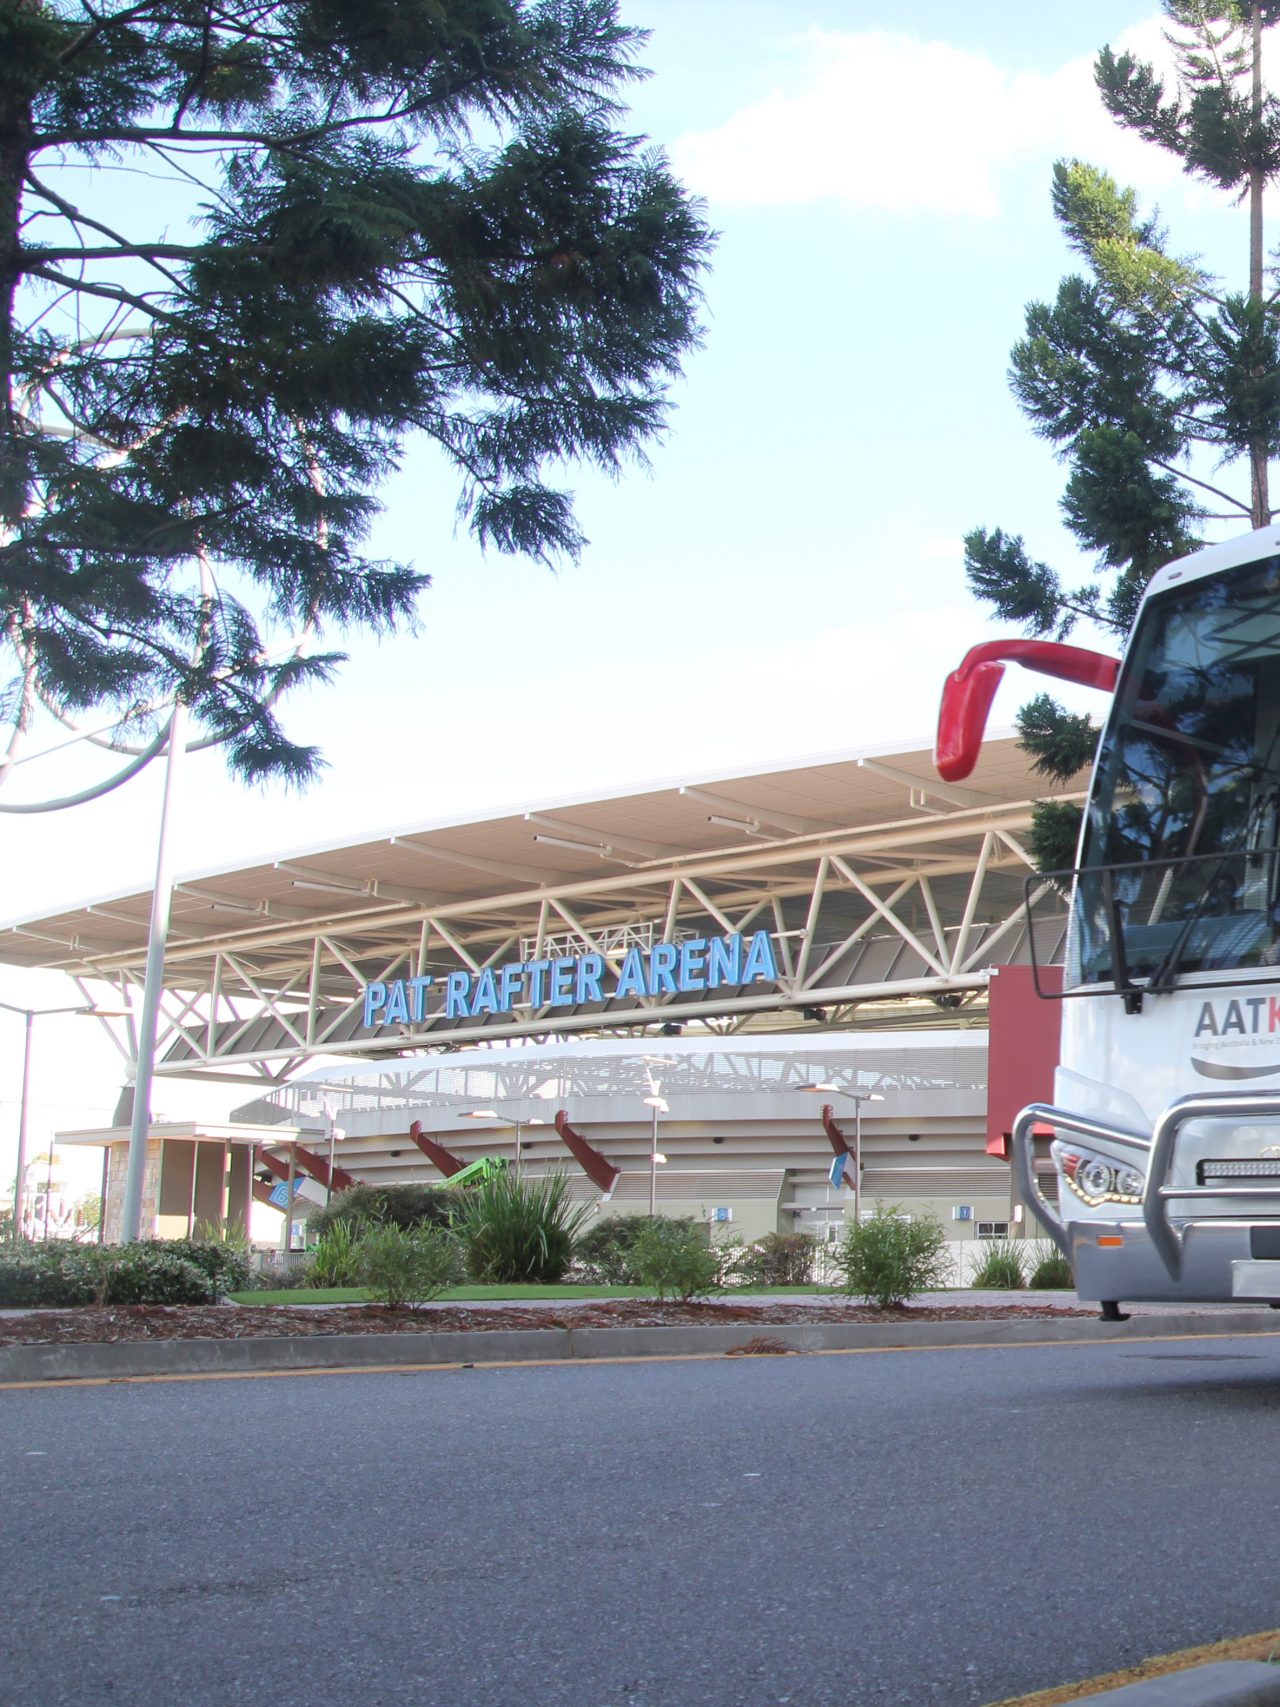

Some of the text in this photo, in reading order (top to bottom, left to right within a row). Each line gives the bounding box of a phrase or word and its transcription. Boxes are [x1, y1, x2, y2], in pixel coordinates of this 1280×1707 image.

[363, 930, 779, 1029] PAT RAFTER ARENA
